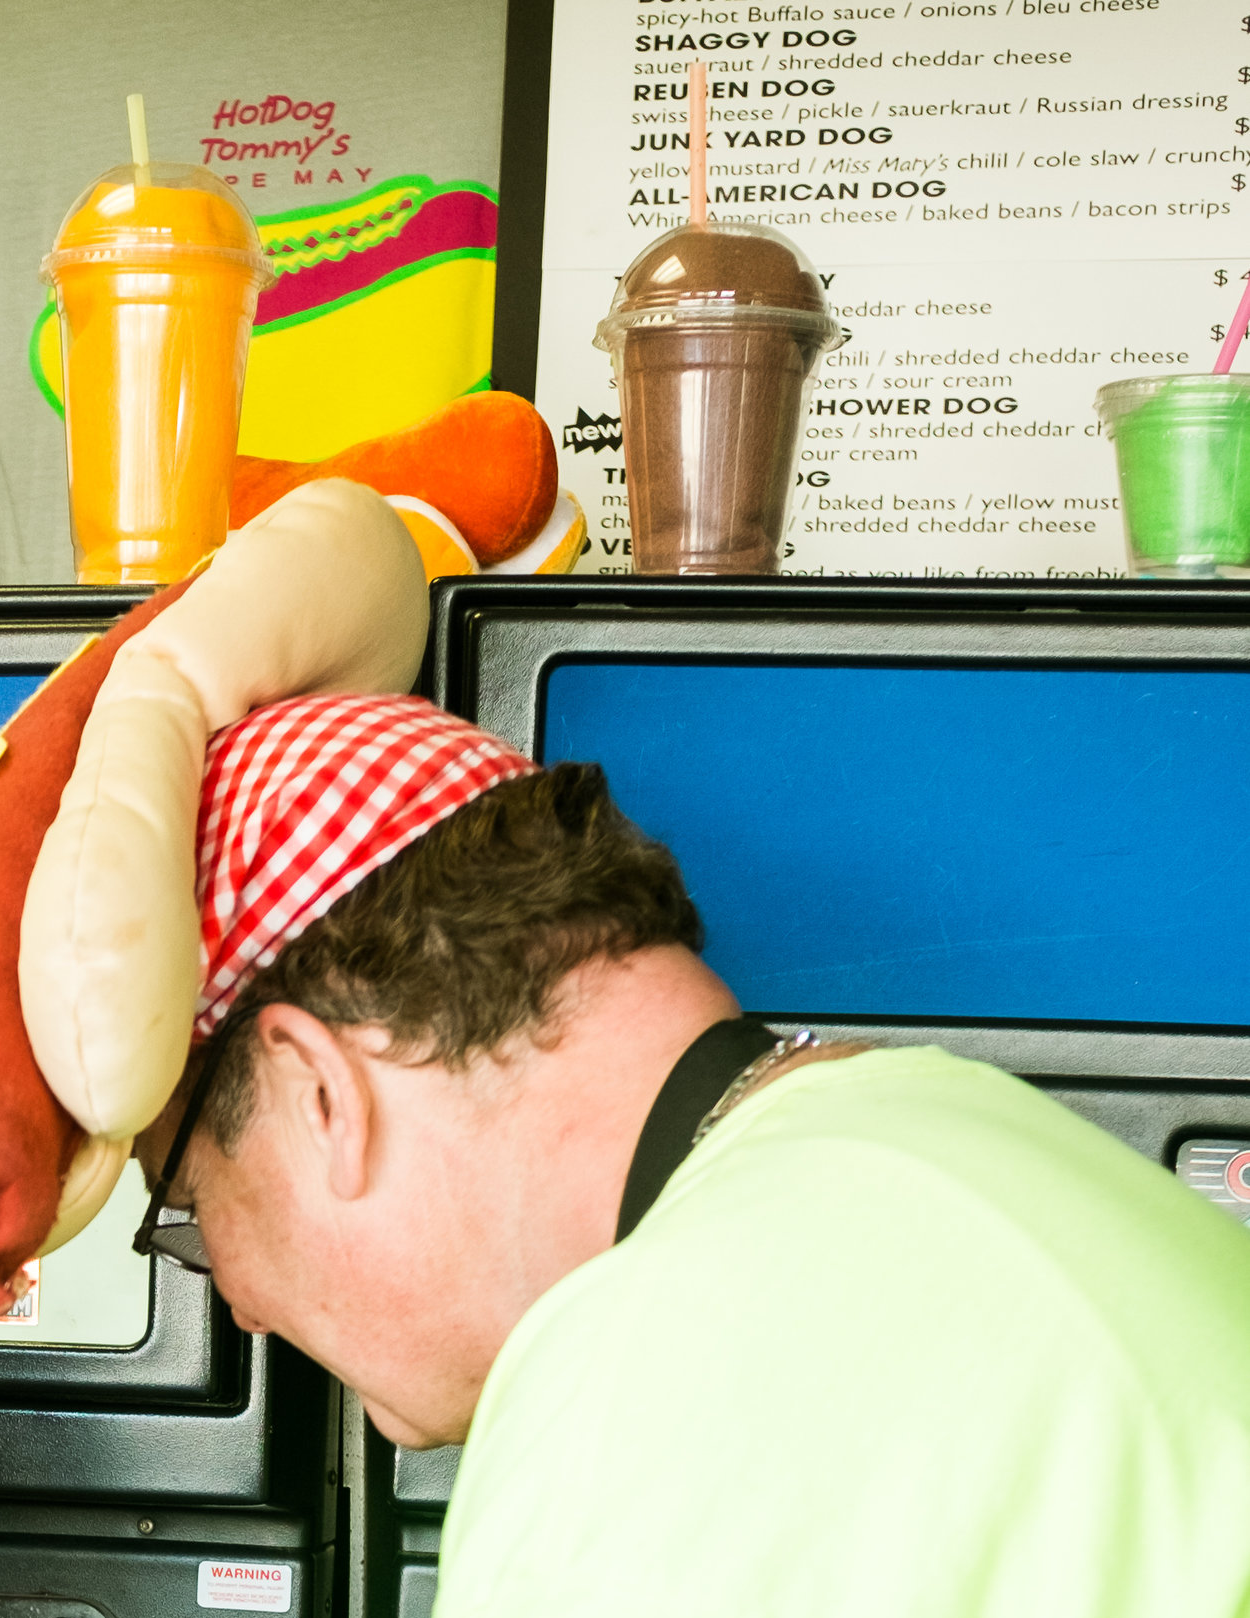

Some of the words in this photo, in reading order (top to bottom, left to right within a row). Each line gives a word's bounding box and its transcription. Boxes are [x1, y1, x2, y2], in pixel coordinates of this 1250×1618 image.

[635, 8, 740, 30] spicy-hot
[748, 5, 824, 23] Buffalo
[832, 6, 896, 20] sauce
[920, 2, 997, 18] onions
[1022, 0, 1070, 16] bleu
[1079, 0, 1160, 13] cheese
[634, 31, 771, 52] SHAGGY
[781, 29, 858, 48] DOG
[633, 57, 755, 75] sauerraut
[777, 52, 883, 71] shredded
[892, 49, 985, 68] cheddar
[993, 48, 1073, 65] cheese
[633, 81, 749, 102] REUEN
[761, 78, 836, 98] DOG
[631, 108, 688, 125] swiss
[705, 104, 774, 122] heese
[798, 101, 864, 124] pickle
[887, 99, 1012, 117] sauerkraut
[1037, 95, 1122, 114] Russian
[1131, 91, 1228, 112] dressing
[200, 127, 351, 165] Tommy's
[724, 129, 806, 149] YARD
[817, 126, 894, 146] DOG
[709, 158, 800, 178] mustard
[822, 156, 870, 174] Miss
[877, 153, 949, 177] Mary's
[1033, 150, 1082, 168] cole
[1089, 149, 1140, 166] slaw
[293, 167, 373, 185] MAY
[628, 182, 859, 206] ALL-MERICAN
[871, 179, 947, 199] DOG
[820, 206, 898, 225] cheese
[922, 202, 989, 222] baked
[998, 202, 1063, 220] beans
[1088, 200, 1158, 218] bacon
[1166, 198, 1231, 219] strips
[914, 299, 993, 316] cheese
[825, 350, 870, 367] chili
[893, 348, 1000, 367] shredded
[1008, 347, 1102, 365] cheddar
[1110, 347, 1190, 364] cheese
[883, 376, 935, 390] sour
[942, 374, 1013, 388] cream
[943, 396, 1019, 415] DOG
[564, 422, 622, 443] new
[869, 421, 974, 439] shredded
[982, 420, 1076, 438] cheddar
[849, 448, 919, 462] cream
[818, 493, 884, 511] baked
[893, 494, 957, 511] beans
[981, 493, 1055, 515] yellow
[803, 516, 909, 533] shredded
[917, 516, 1010, 533] cheddar
[1017, 516, 1097, 533] cheese
[211, 1567, 282, 1581] WARNING
